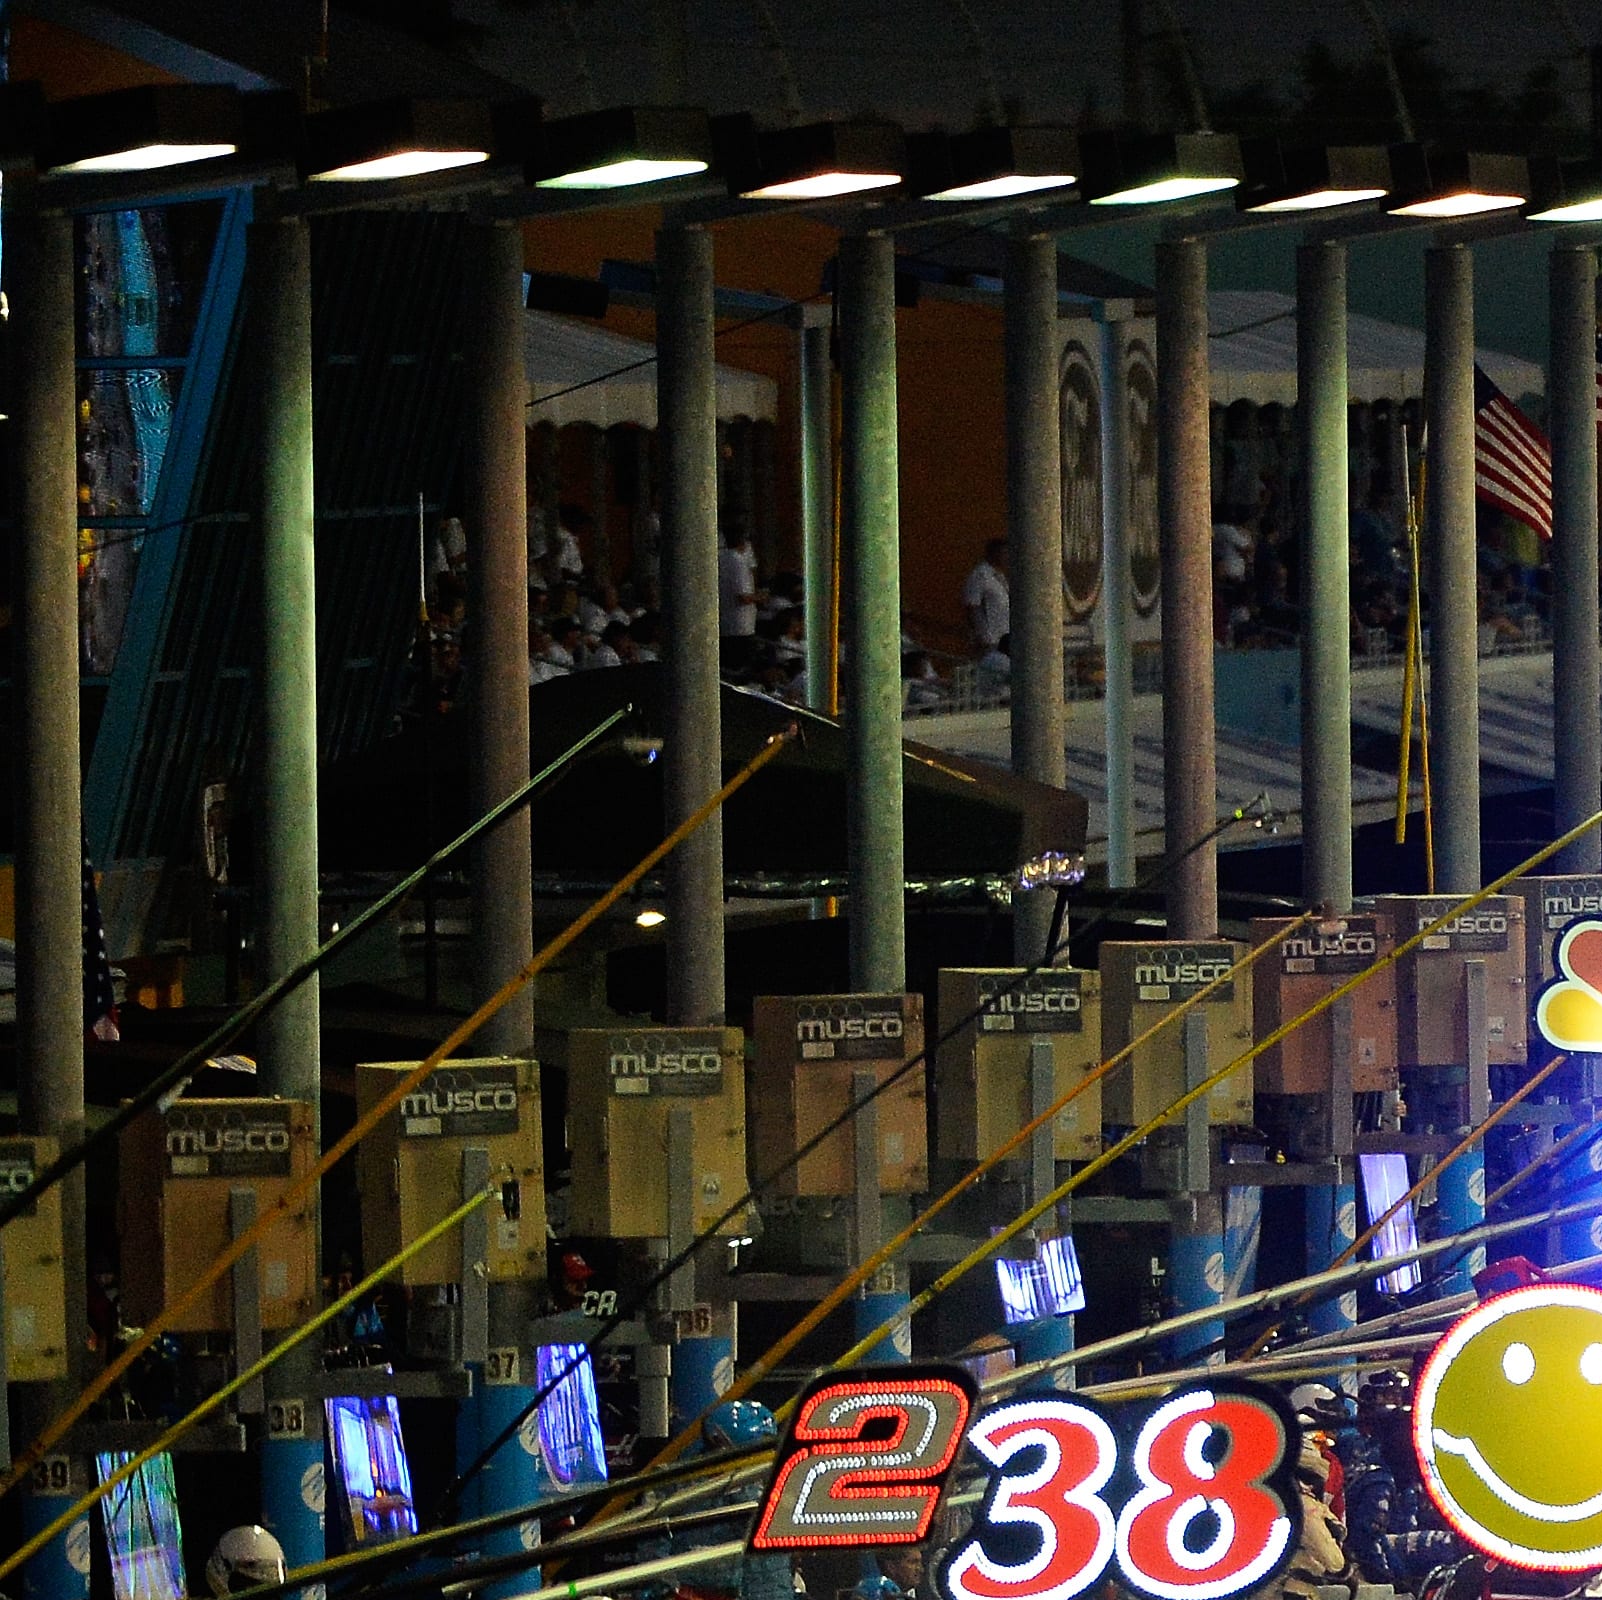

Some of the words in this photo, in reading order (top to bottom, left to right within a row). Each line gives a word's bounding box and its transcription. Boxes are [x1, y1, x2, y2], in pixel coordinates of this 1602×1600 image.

[1282, 935, 1377, 957] MUSCO
[1135, 963, 1233, 985] MUSCO
[796, 1016, 903, 1042] MUSCO
[610, 1052, 722, 1075] MUSCO
[400, 1088, 517, 1116] MUSCO
[165, 1128, 290, 1155] MUSCO
[750, 1377, 971, 1553] 2
